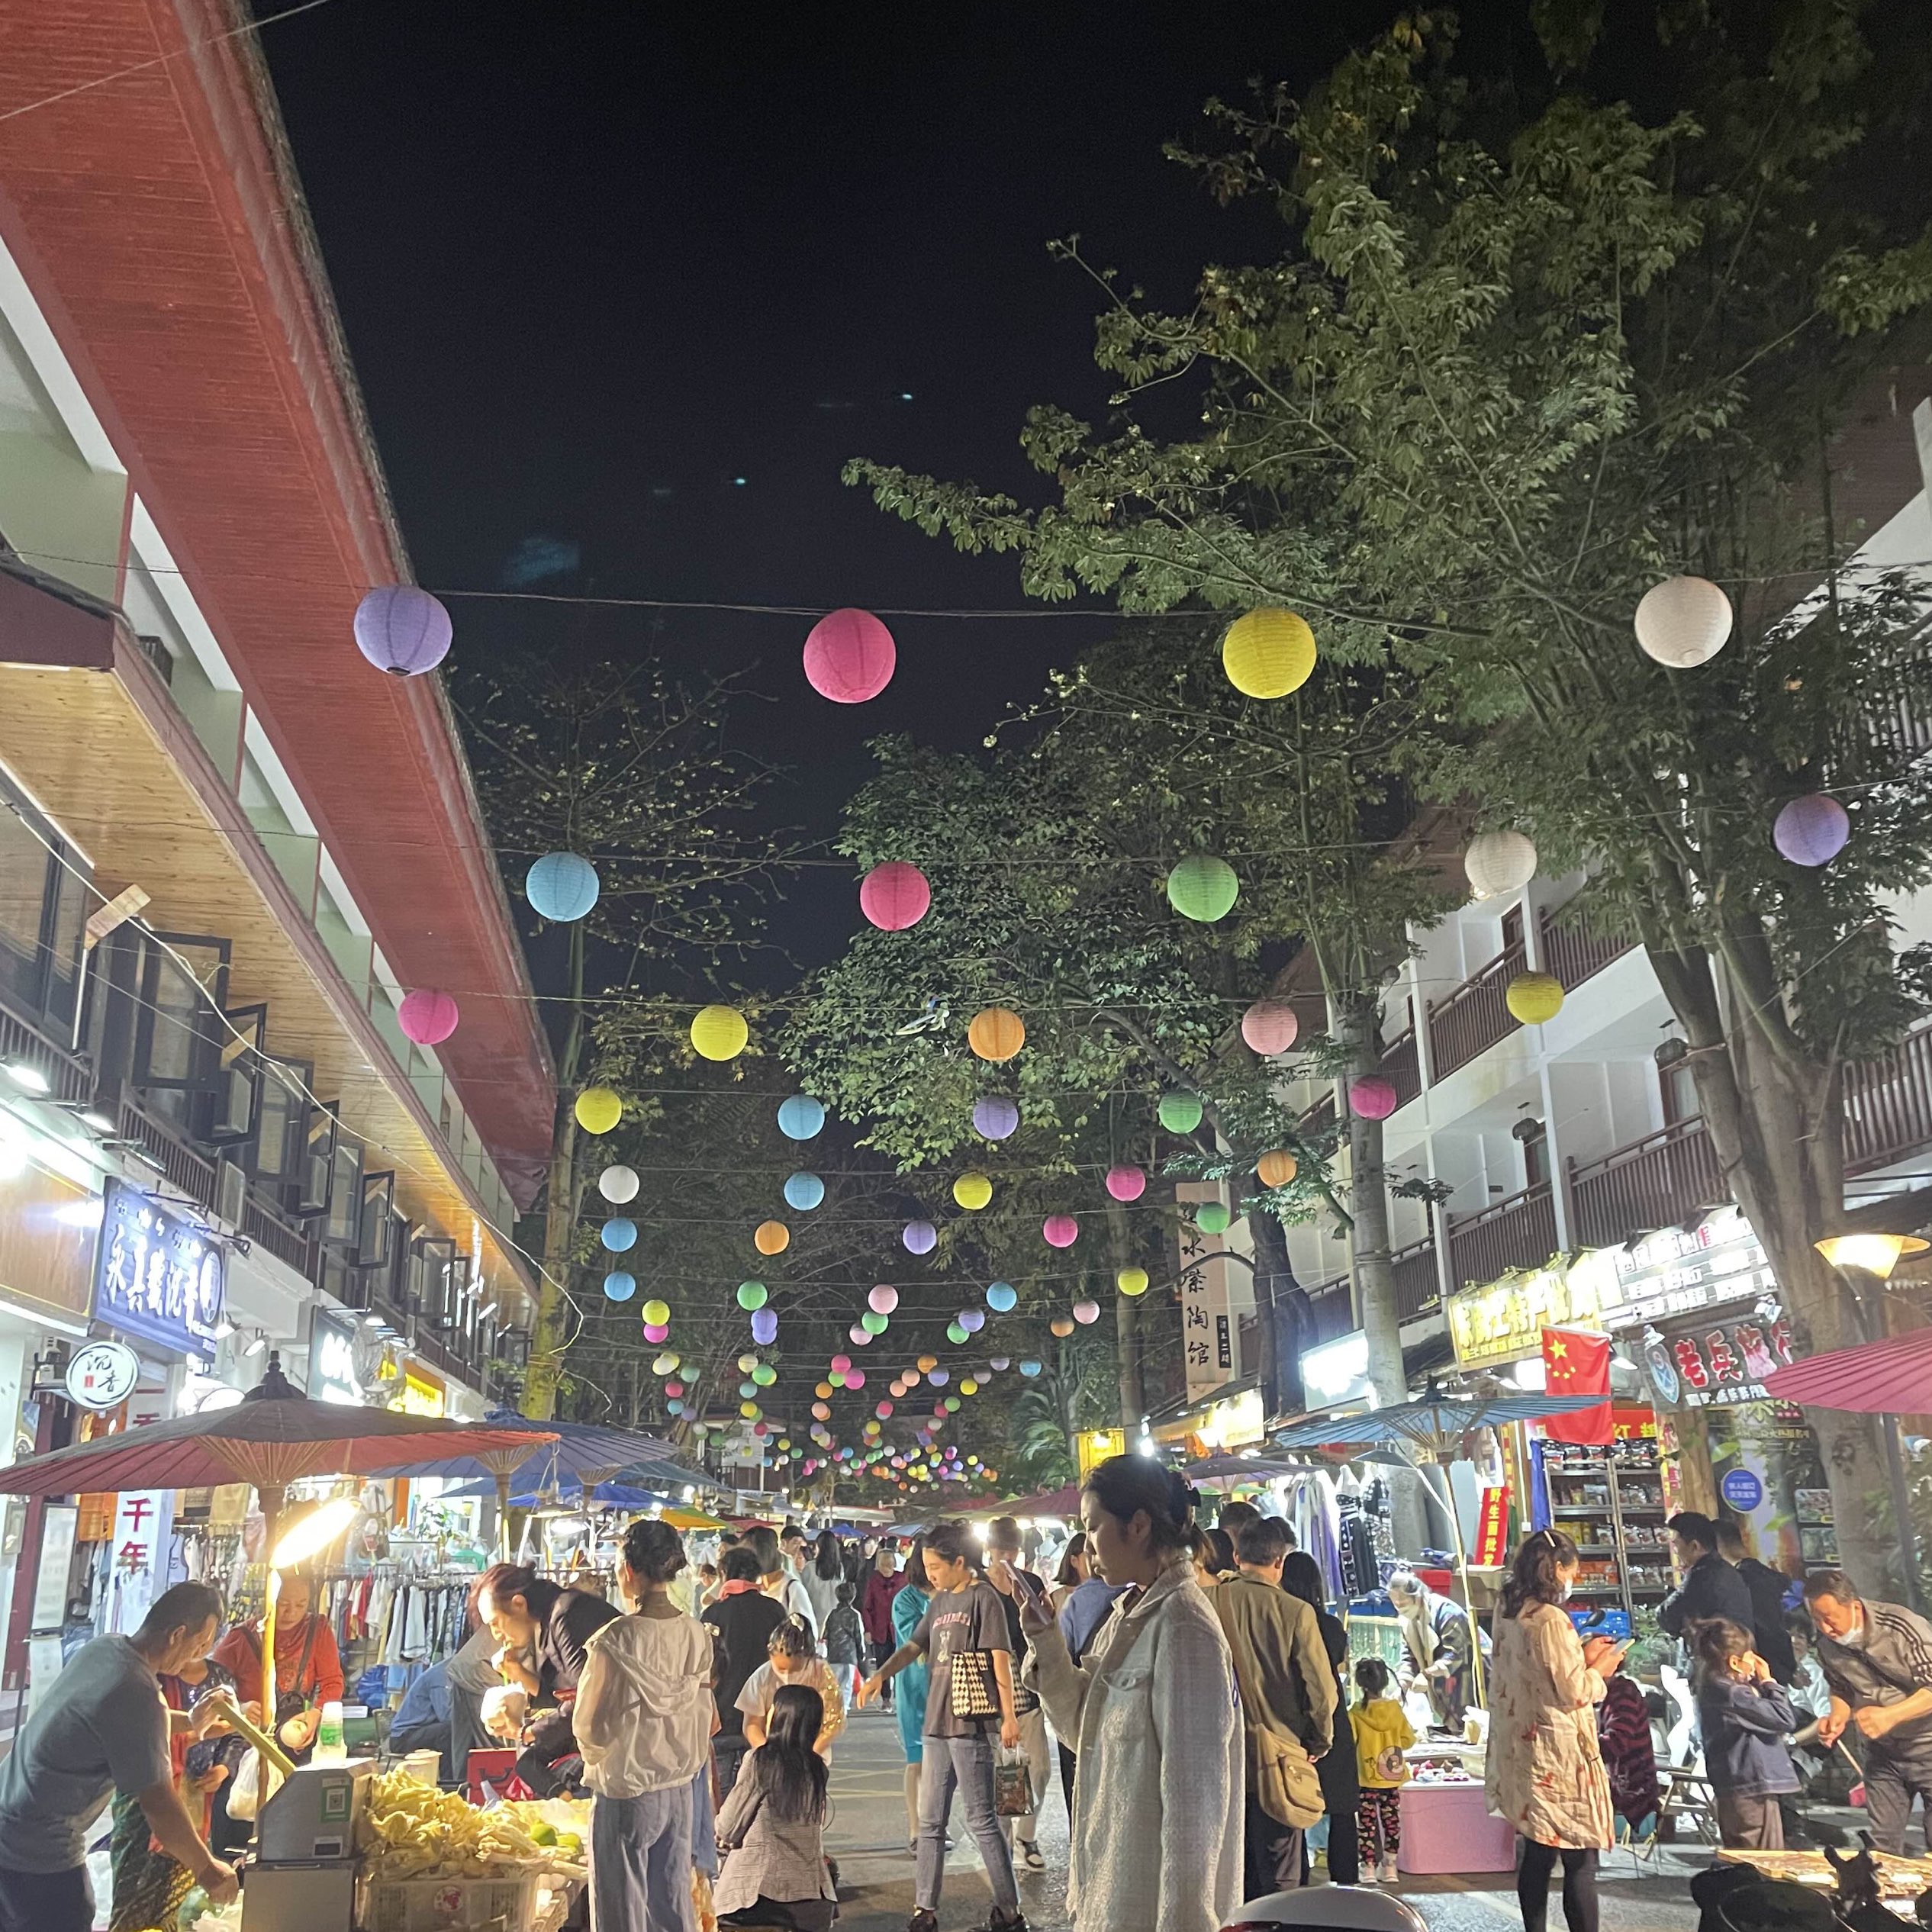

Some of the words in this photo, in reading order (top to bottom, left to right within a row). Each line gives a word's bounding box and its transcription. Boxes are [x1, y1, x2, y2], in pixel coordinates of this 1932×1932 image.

[1181, 1206, 1209, 1367] 水紫陶馆
[87, 1354, 120, 1392] 沉香
